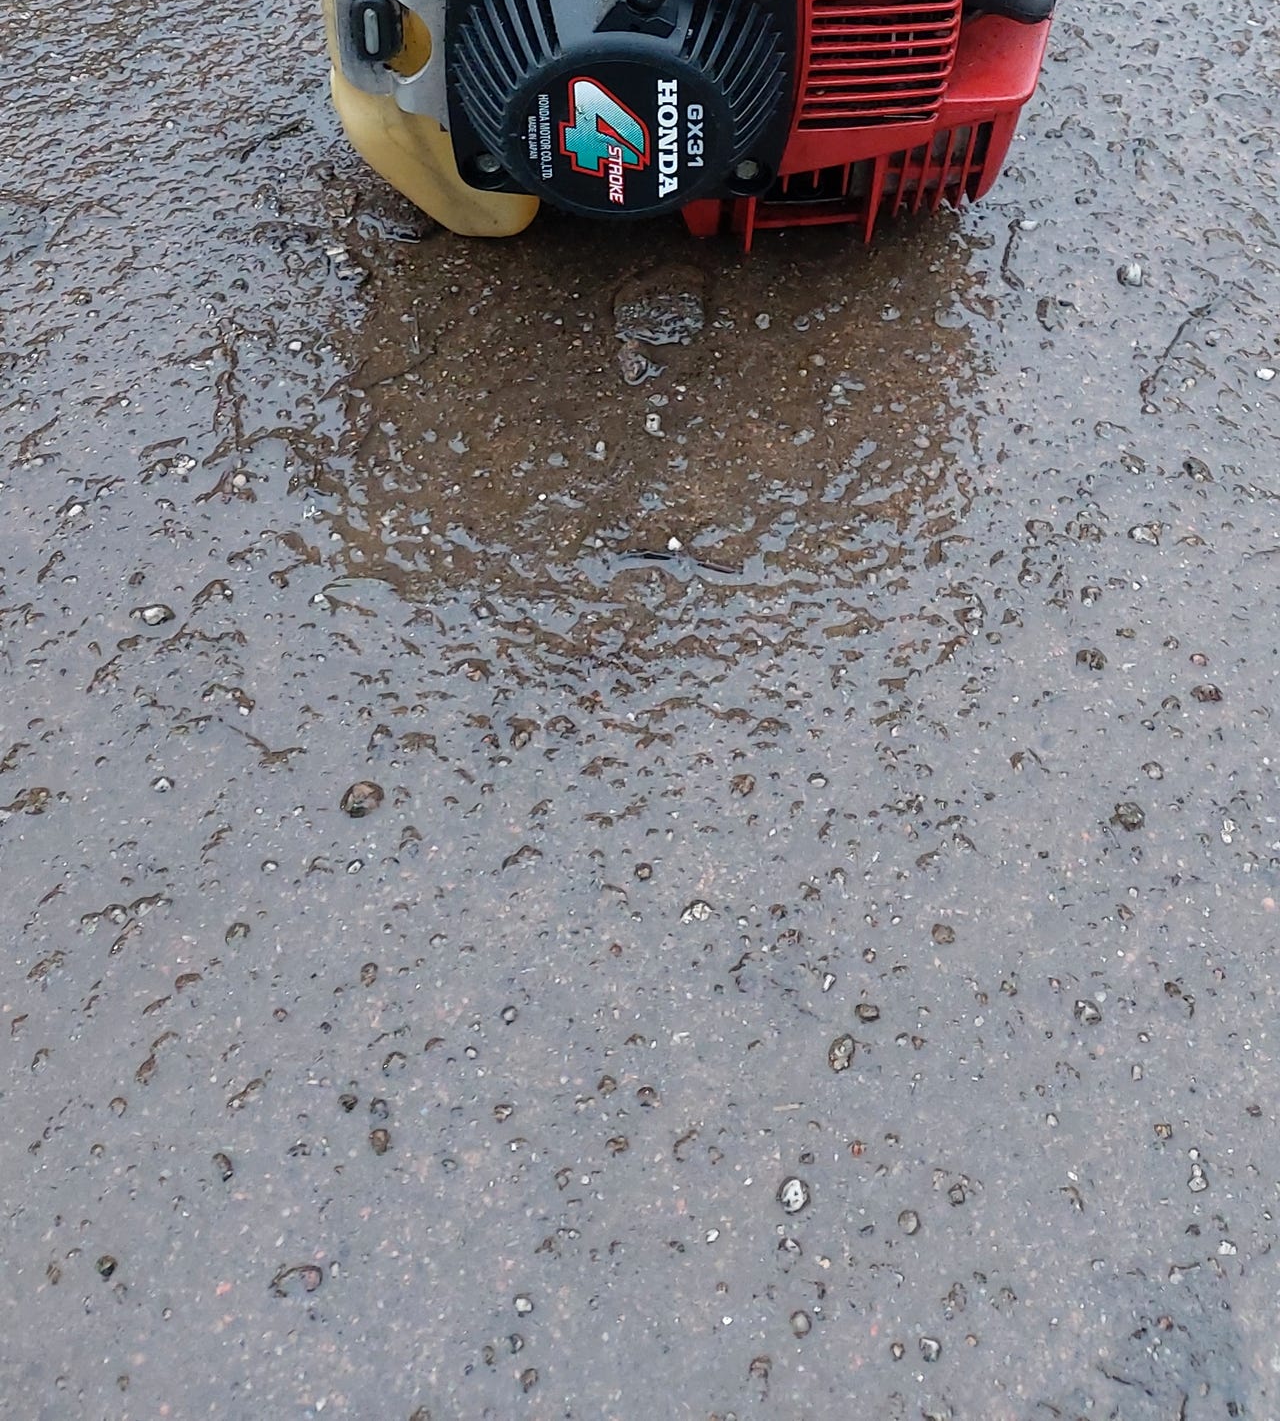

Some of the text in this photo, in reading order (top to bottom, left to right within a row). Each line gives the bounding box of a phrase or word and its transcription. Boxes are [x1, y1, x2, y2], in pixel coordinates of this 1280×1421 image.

[528, 115, 537, 133] MADE
[538, 94, 550, 121] HONDA
[560, 77, 649, 177] 4
[529, 141, 538, 159] JAPAN
[540, 122, 551, 150] MOTOR
[657, 79, 679, 198] HONDA
[686, 104, 704, 167] GX31
[607, 144, 625, 205] STROKE
